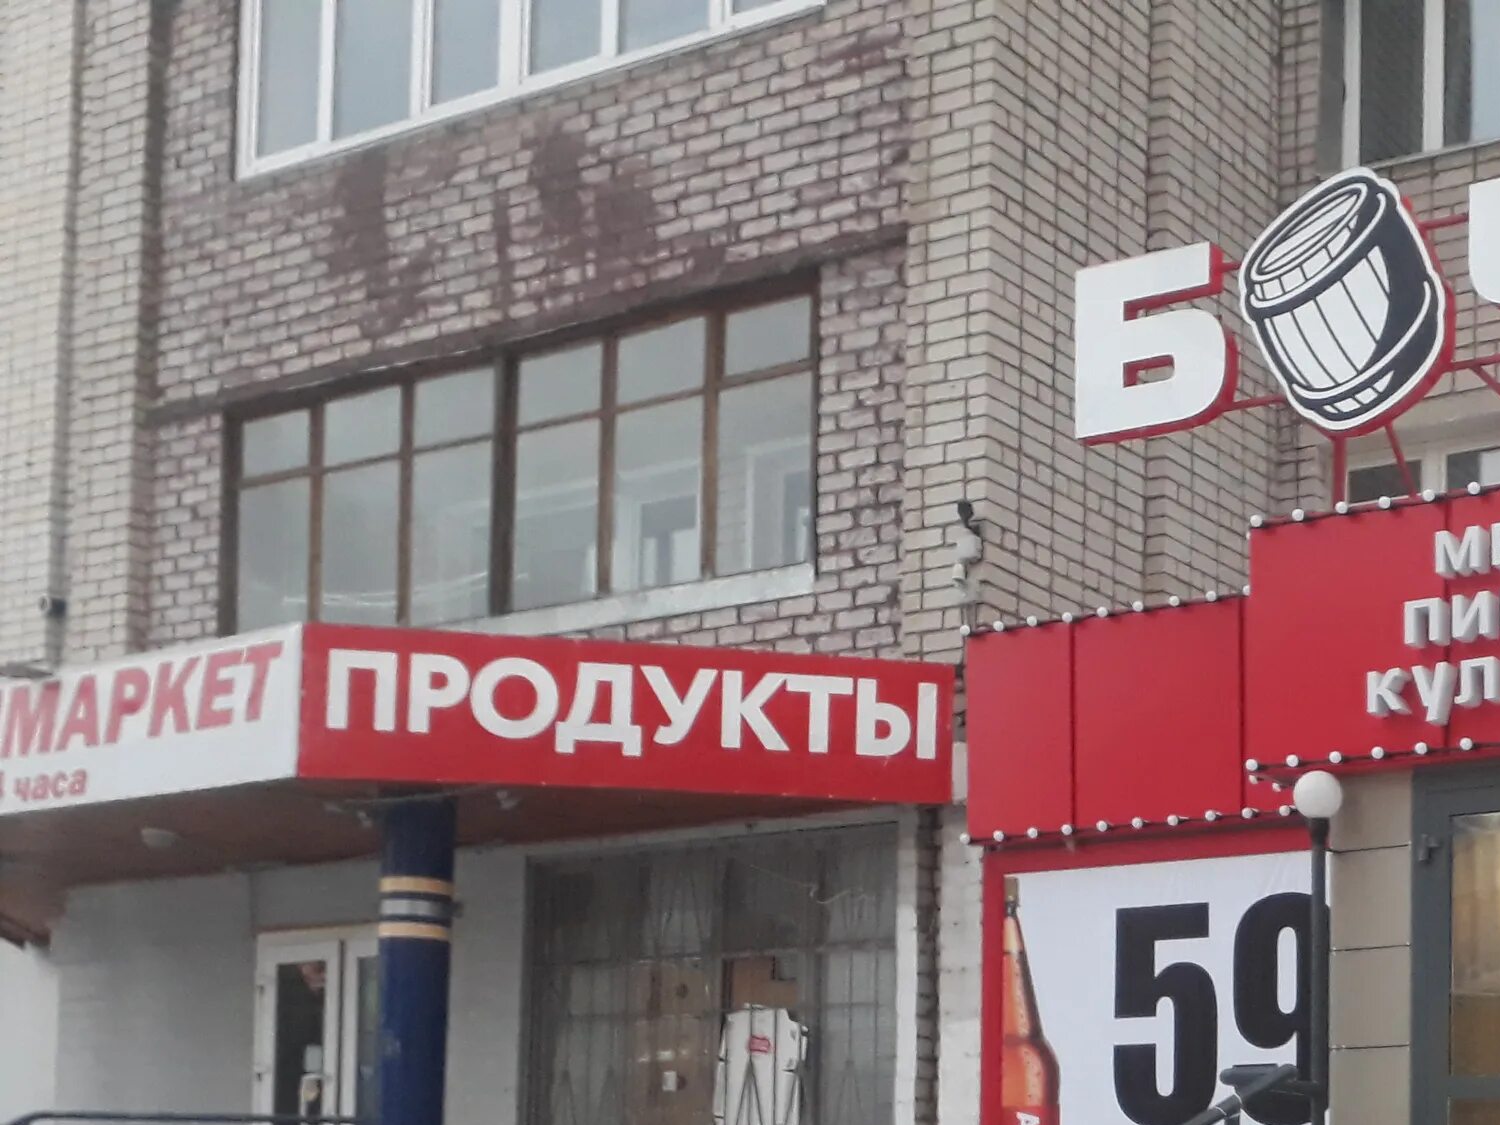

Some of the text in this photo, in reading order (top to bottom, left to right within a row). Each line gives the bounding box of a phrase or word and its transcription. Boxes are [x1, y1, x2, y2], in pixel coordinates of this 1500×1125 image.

[0, 640, 284, 759] МАРКЕТ
[326, 648, 938, 760] ПРОДУКТЫ
[13, 768, 88, 801] часа
